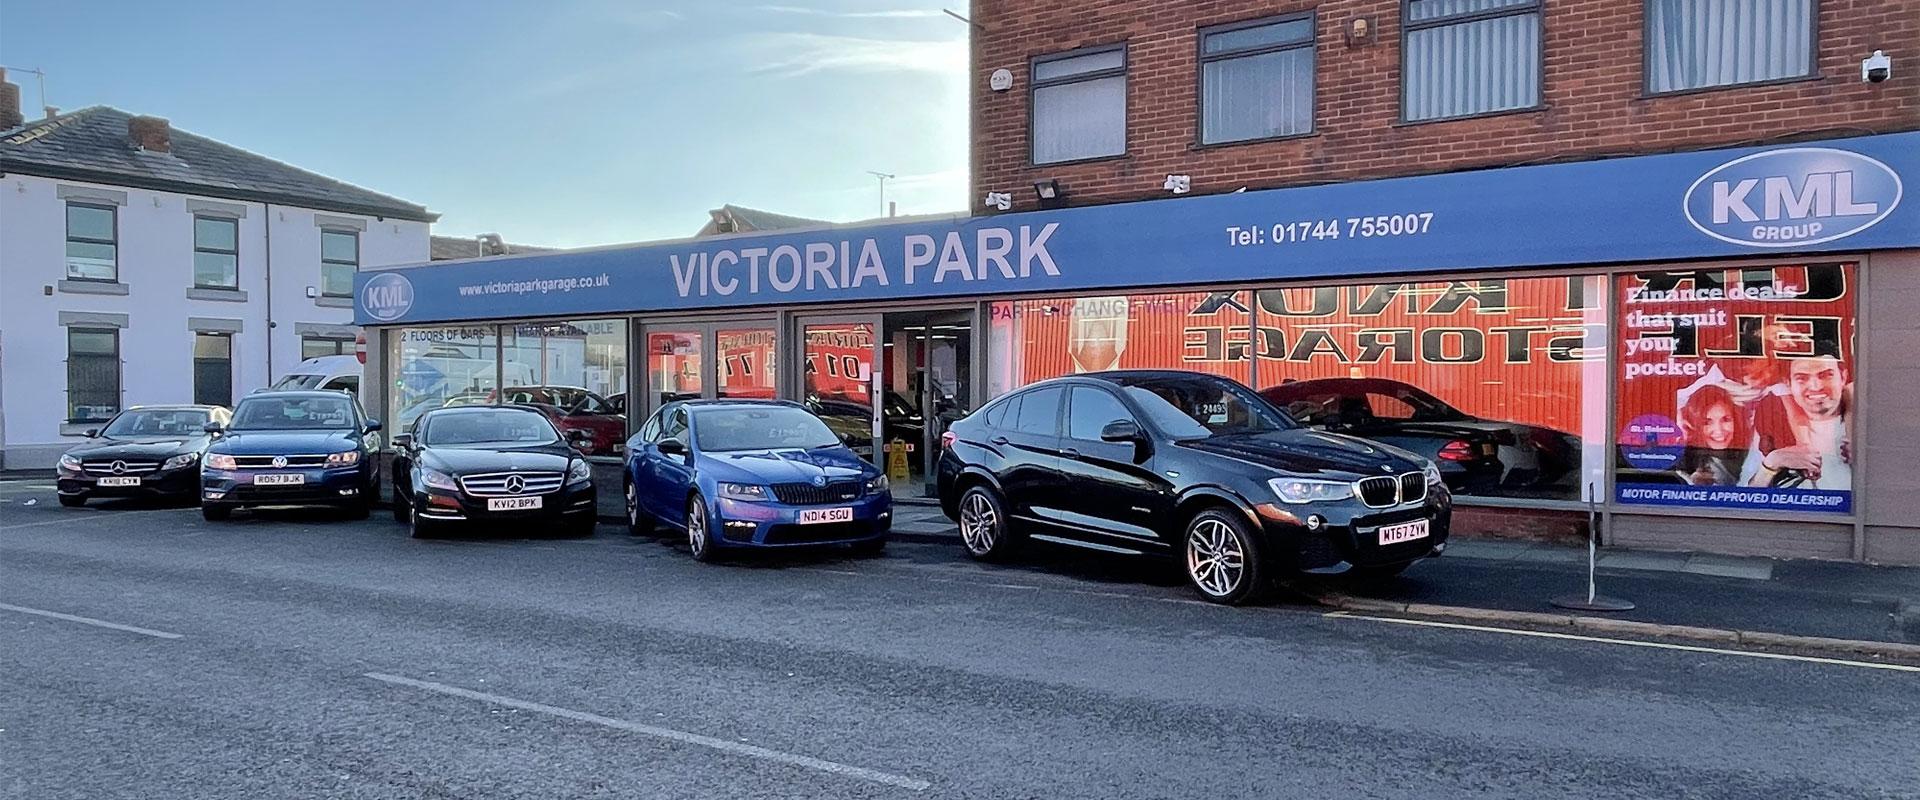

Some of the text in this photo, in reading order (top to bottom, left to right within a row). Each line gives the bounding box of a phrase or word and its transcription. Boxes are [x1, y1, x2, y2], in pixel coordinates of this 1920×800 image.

[1713, 170, 1878, 224] KML
[1226, 212, 1434, 246] Tel: 01744 755007
[1752, 222, 1823, 240] GROUP
[669, 222, 1061, 297] VICTORIA PARK
[459, 273, 610, 296] www.victoriaparkgarage.co.uk
[1625, 281, 1798, 303] Finance deals
[368, 286, 409, 309] KML
[1625, 308, 1727, 328] that suit
[1625, 336, 1679, 356] your
[1625, 358, 1707, 379] pocket
[1622, 488, 1844, 507] MOTOR FINANCE APPROVED DEALERSHIP
